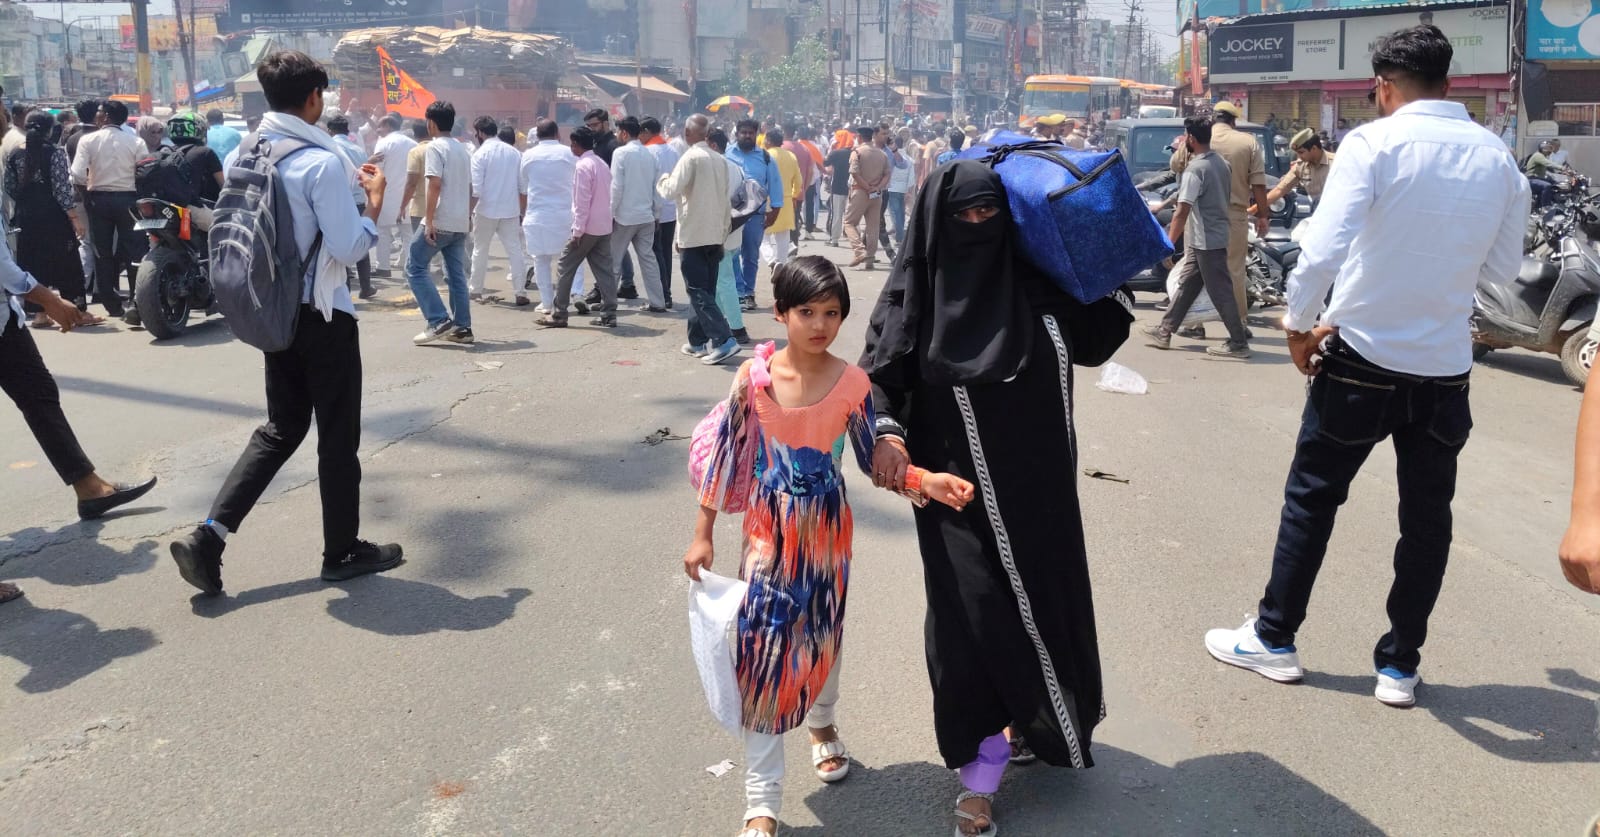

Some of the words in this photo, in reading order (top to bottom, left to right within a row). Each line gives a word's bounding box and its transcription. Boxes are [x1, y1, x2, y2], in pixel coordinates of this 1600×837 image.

[1469, 8, 1506, 17] JOCKEY
[1220, 37, 1283, 53] JOCKEY
[1298, 39, 1336, 47] PREFERRED
[1450, 36, 1483, 47] ETTER
[161, 207, 174, 219] 05
